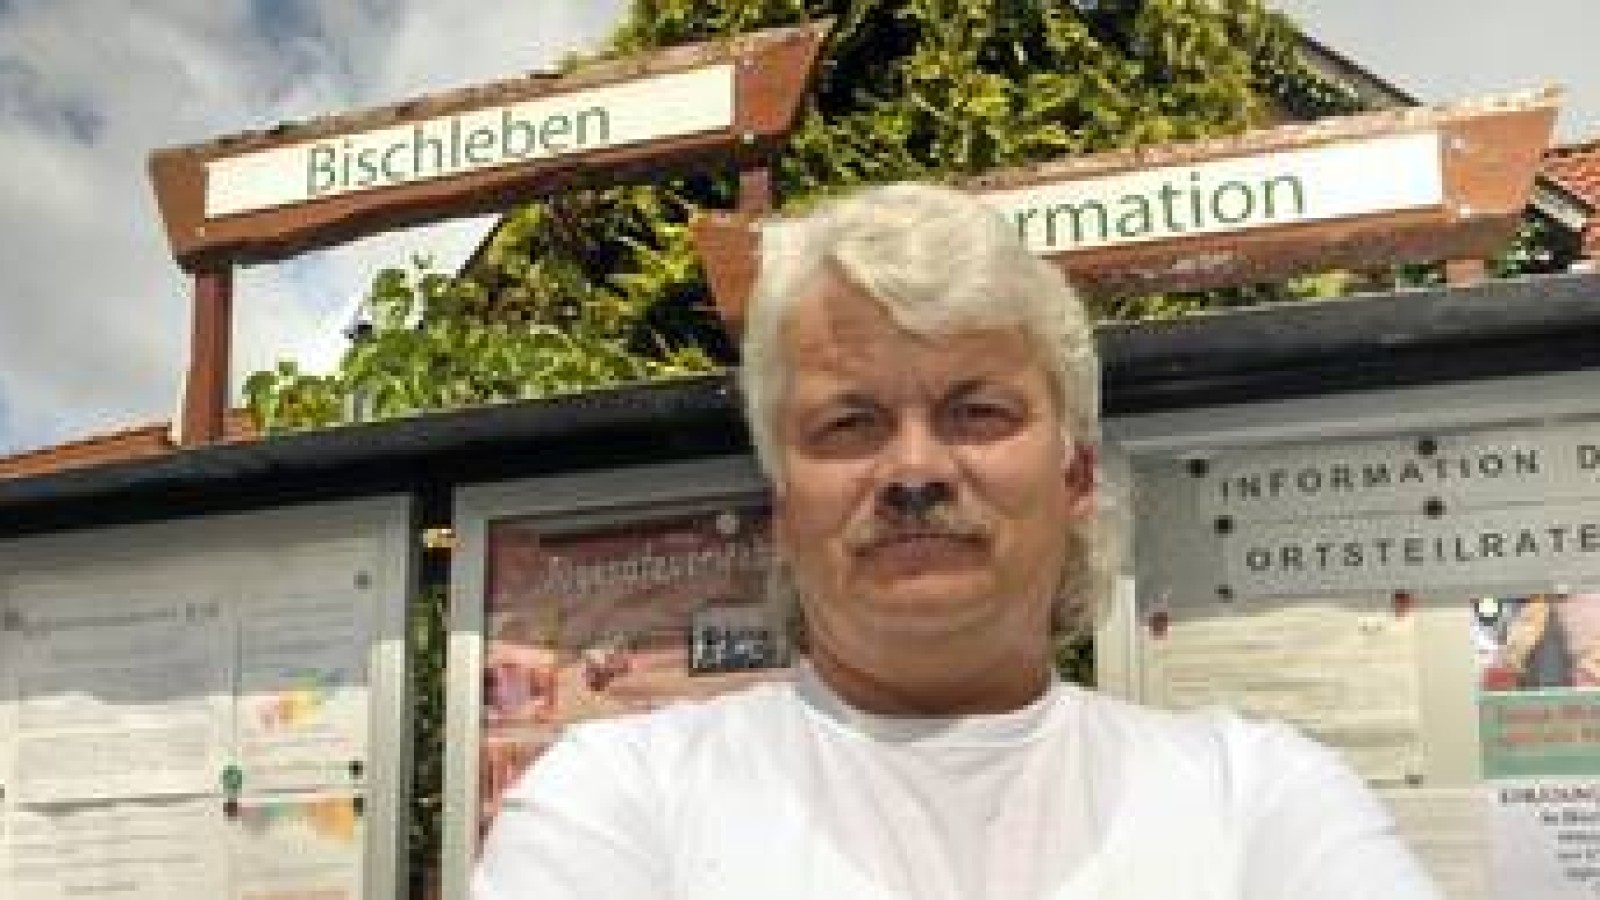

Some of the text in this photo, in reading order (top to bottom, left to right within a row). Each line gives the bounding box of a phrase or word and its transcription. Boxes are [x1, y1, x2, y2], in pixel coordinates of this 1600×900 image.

[306, 105, 610, 196] Bischleben
[1002, 171, 1304, 248] rmation
[1222, 448, 1539, 500] INFORMATION
[1246, 523, 1600, 571] ORTSTEILRATE
